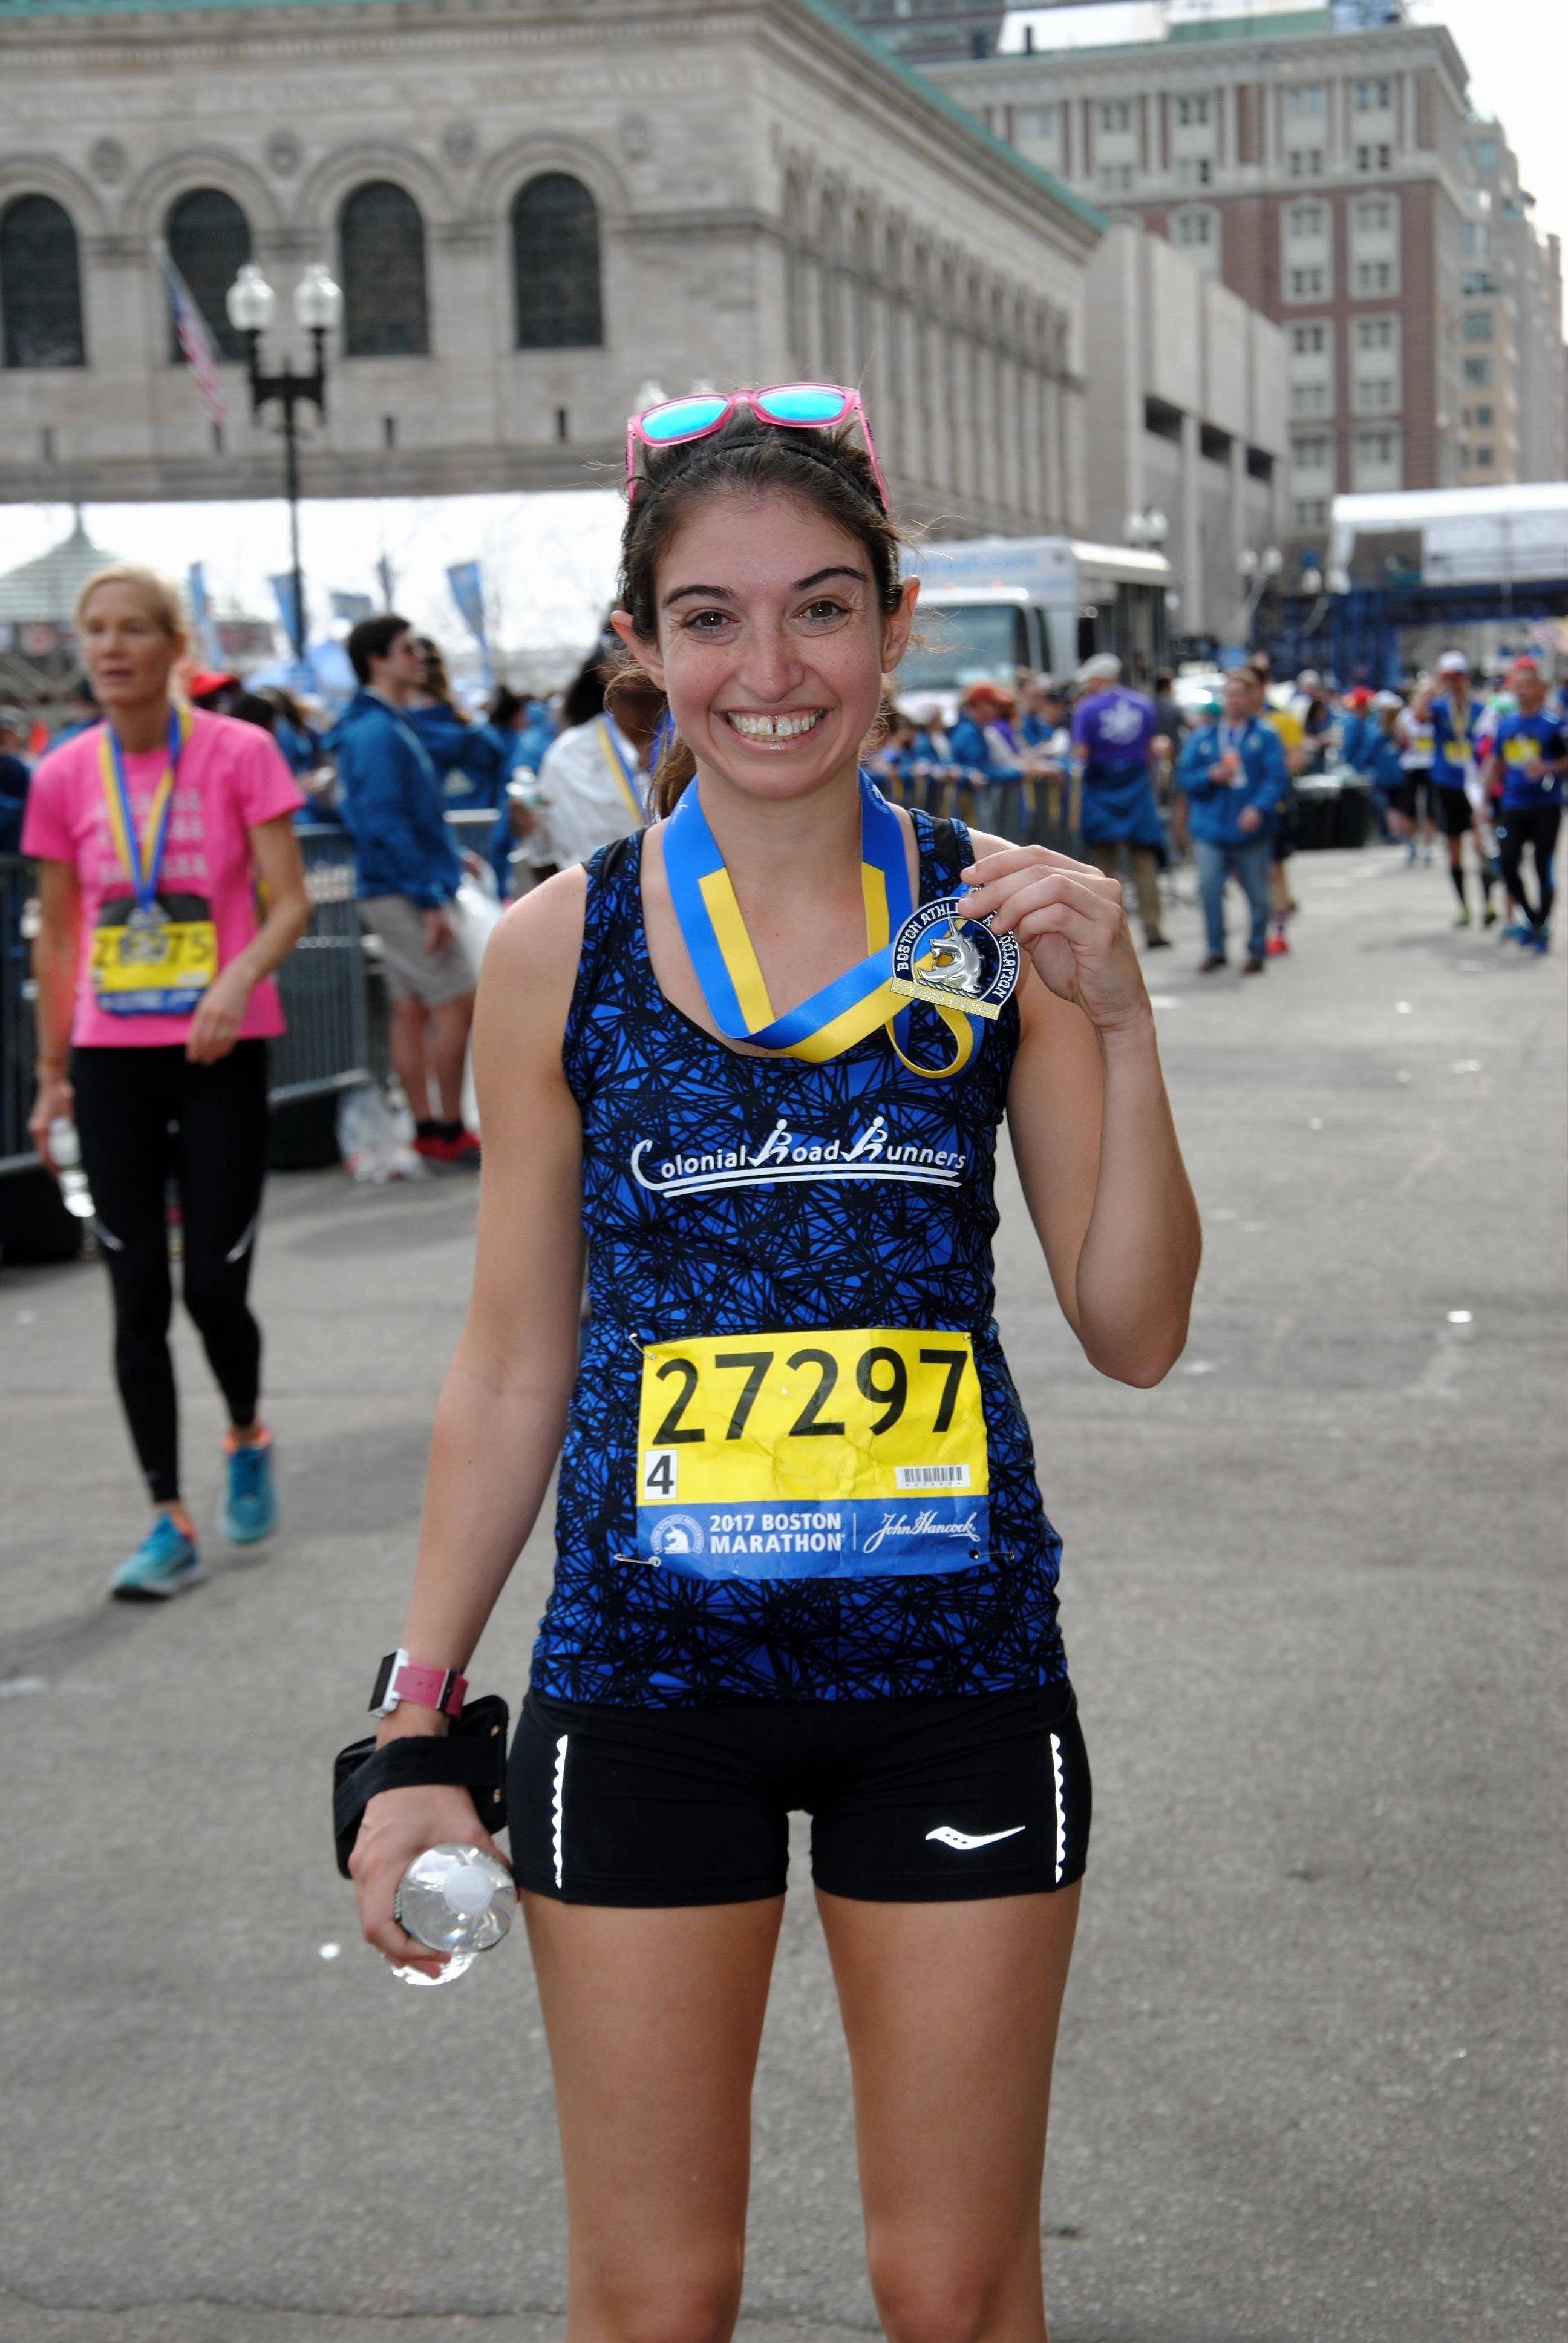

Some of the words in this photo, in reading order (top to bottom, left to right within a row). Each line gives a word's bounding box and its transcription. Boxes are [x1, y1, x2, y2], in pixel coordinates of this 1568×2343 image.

[896, 920, 923, 972] BOSTON
[921, 902, 959, 926] ATHL
[630, 1139, 748, 1191] Colonial
[747, 1119, 840, 1167] Road
[840, 1116, 967, 1169] Runners
[652, 1346, 969, 1446] 27297
[646, 1455, 675, 1496] 4
[709, 1513, 756, 1532] 2017
[762, 1512, 841, 1532] BOSTON
[710, 1532, 842, 1554] MARATHON
[863, 1512, 912, 1553] John
[912, 1510, 981, 1542] Hancock
